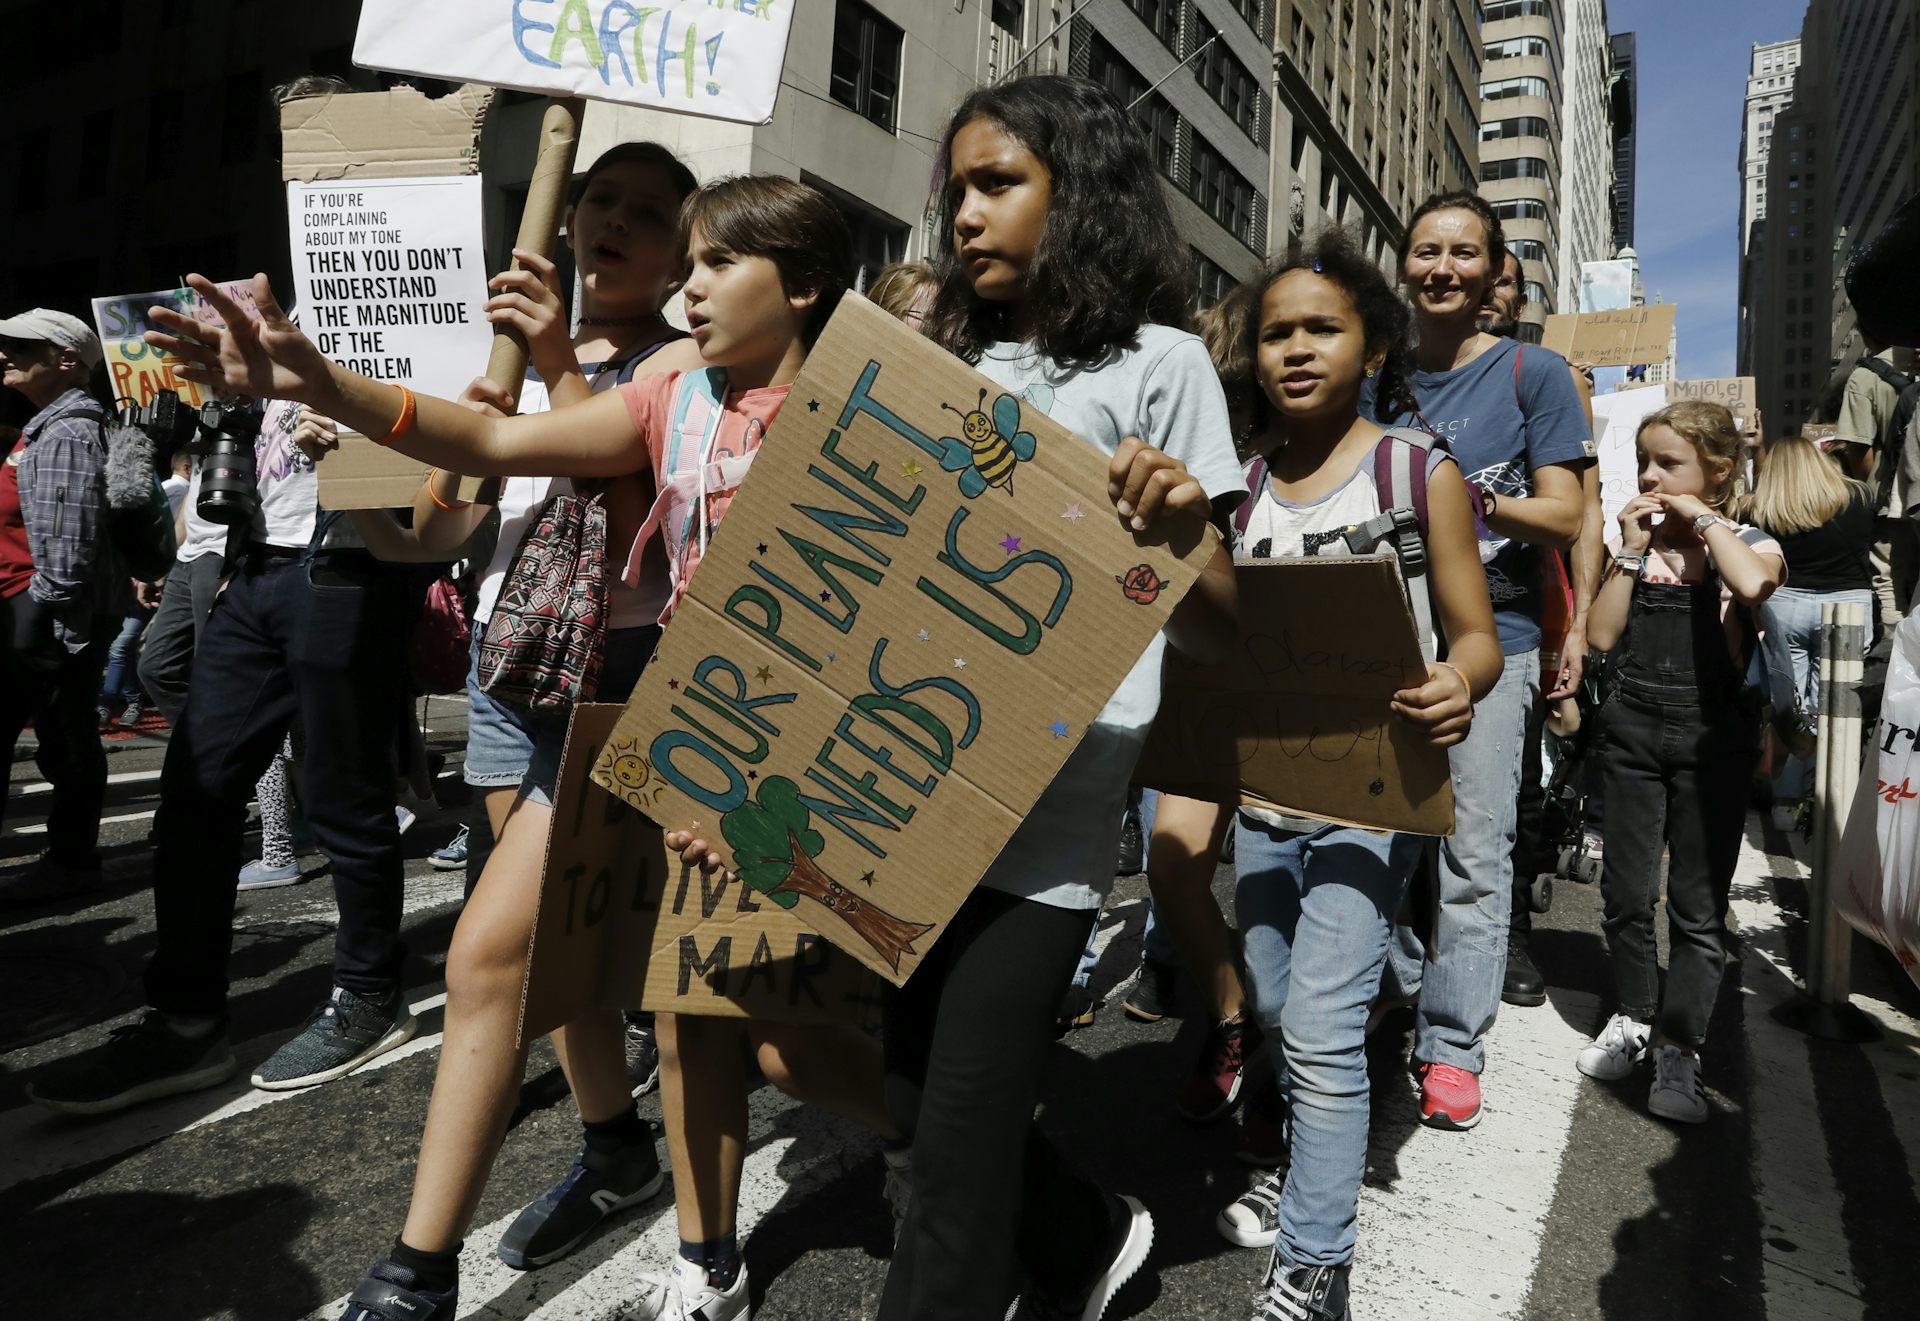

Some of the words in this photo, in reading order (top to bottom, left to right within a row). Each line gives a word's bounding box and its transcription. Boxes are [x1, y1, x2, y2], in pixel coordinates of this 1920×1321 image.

[512, 0, 724, 98] EARTH!
[304, 194, 316, 208] IF
[320, 193, 364, 208] YOU'RE
[304, 211, 387, 227] COMPLAINING
[305, 231, 345, 246] ABOUT
[349, 231, 366, 245] MY
[371, 229, 402, 244] TONE
[306, 251, 356, 273] THEN
[361, 249, 400, 272] YOU
[406, 247, 463, 271] DON'T
[310, 276, 437, 301] UNDERSTAND
[313, 305, 351, 327] THE
[357, 302, 469, 327] MAGNITUDE
[318, 331, 342, 354] OF
[348, 331, 385, 354] THE
[649, 655, 798, 812] OUR
[724, 359, 952, 671] PLANET
[797, 637, 982, 858] NEEDS
[916, 506, 1073, 655] US
[562, 861, 612, 937] TO
[676, 930, 872, 1009] MAR
